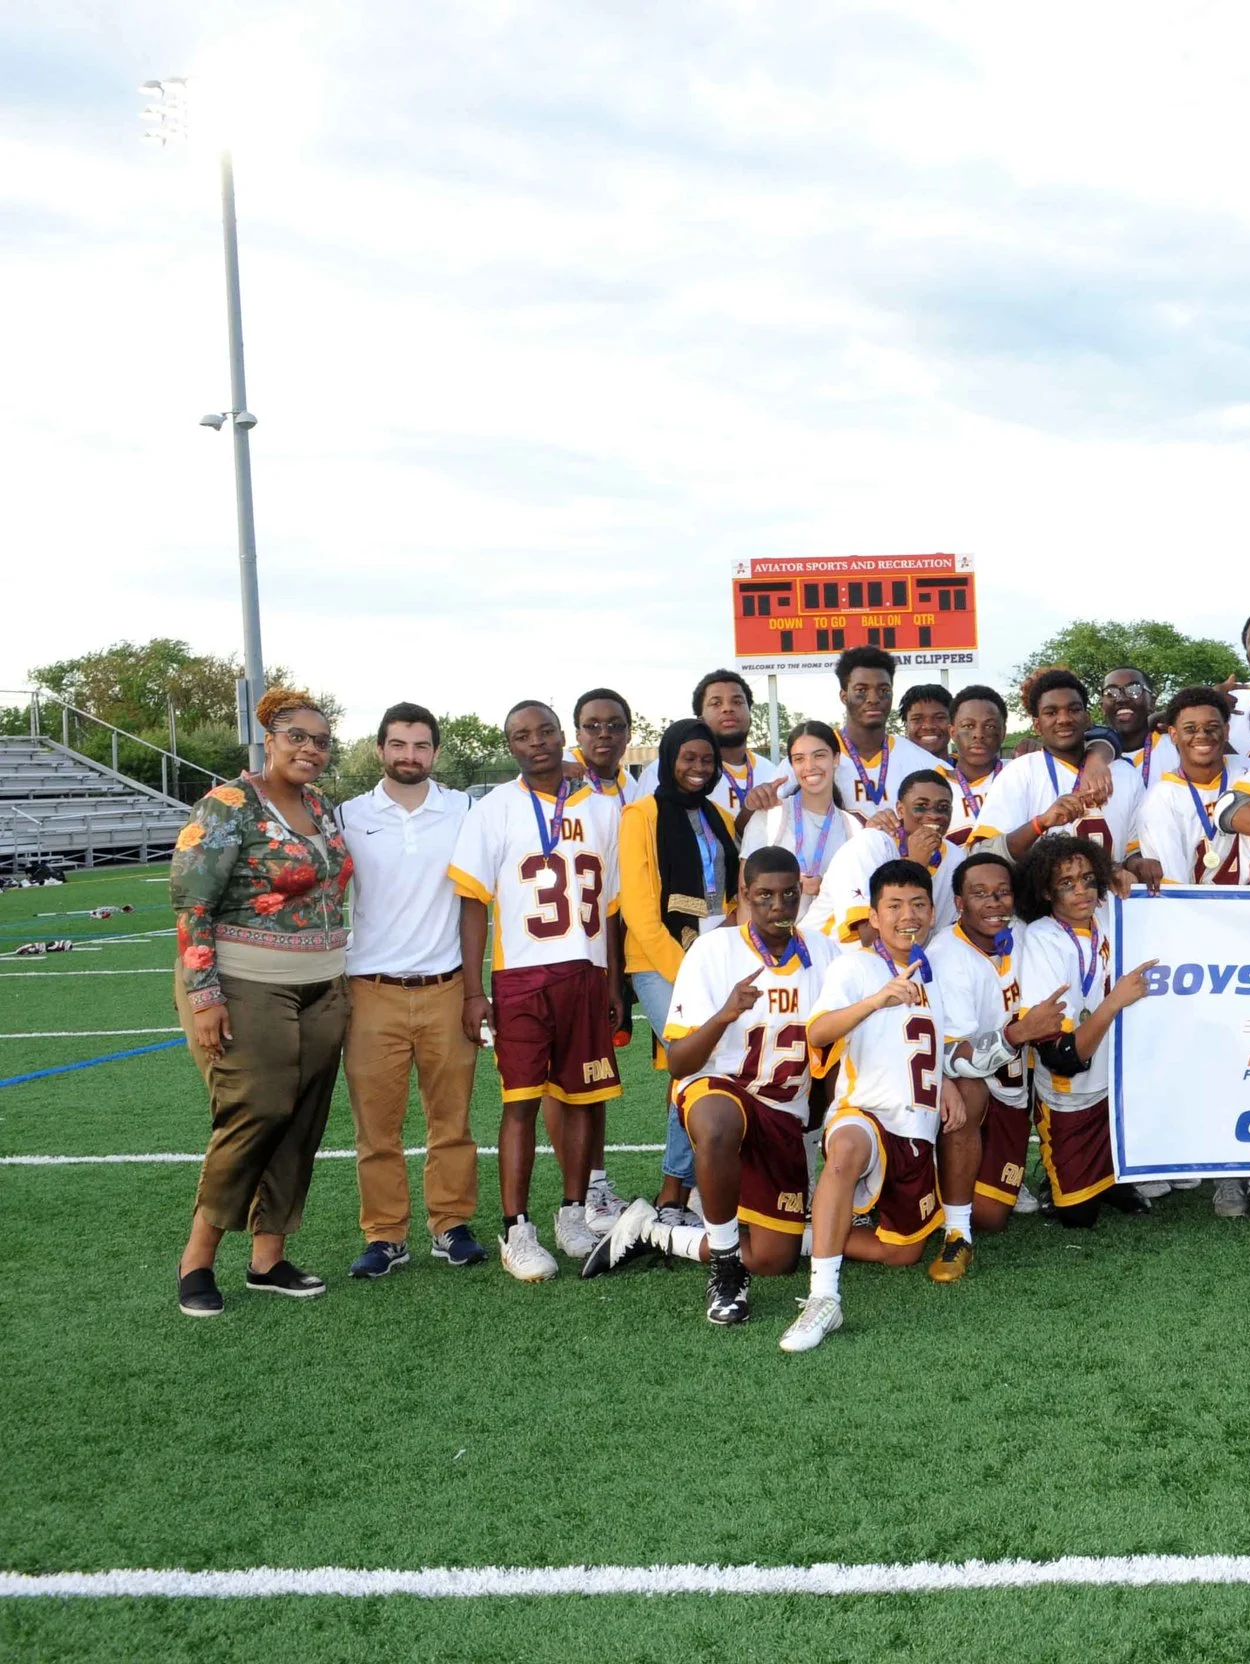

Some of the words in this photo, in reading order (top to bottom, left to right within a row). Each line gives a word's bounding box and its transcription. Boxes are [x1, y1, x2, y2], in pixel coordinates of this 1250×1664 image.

[754, 562, 804, 573] AVIATOR
[805, 561, 848, 571] SPORTS
[850, 560, 876, 570] AND
[878, 558, 953, 569] RECREATION
[769, 617, 803, 630] DOWN
[814, 616, 828, 628] TO
[831, 616, 847, 628] GO
[862, 615, 886, 627] BALL
[888, 614, 902, 626] ON
[913, 613, 935, 626] QTR
[915, 653, 973, 665] CLIPPERS
[741, 663, 775, 671] WELCOME
[549, 817, 585, 842] DA
[517, 850, 606, 942] 33
[767, 987, 799, 1014] FDA
[737, 1022, 810, 1104] 12
[904, 1013, 939, 1112] 2
[583, 1057, 615, 1085] FDA
